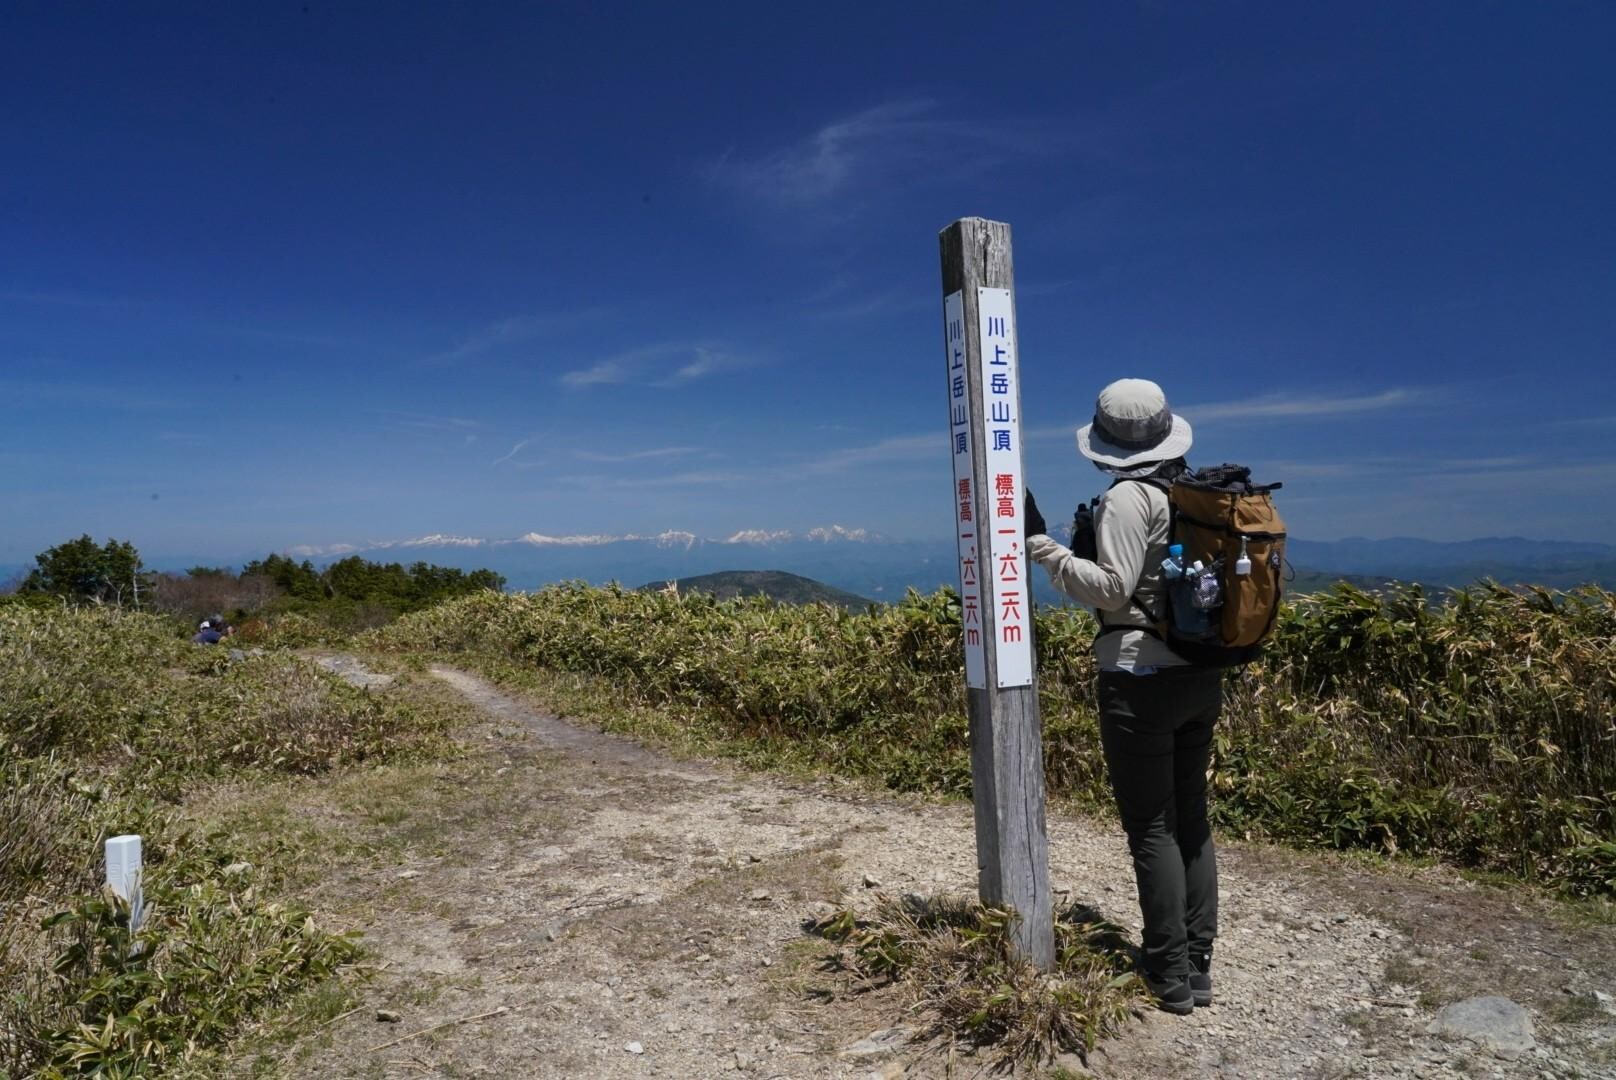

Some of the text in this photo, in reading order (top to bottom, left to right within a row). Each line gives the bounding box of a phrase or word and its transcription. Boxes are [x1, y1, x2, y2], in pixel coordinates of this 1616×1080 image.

[950, 319, 968, 454] 川上岳山頂
[988, 316, 1012, 451] 川上岳山頂
